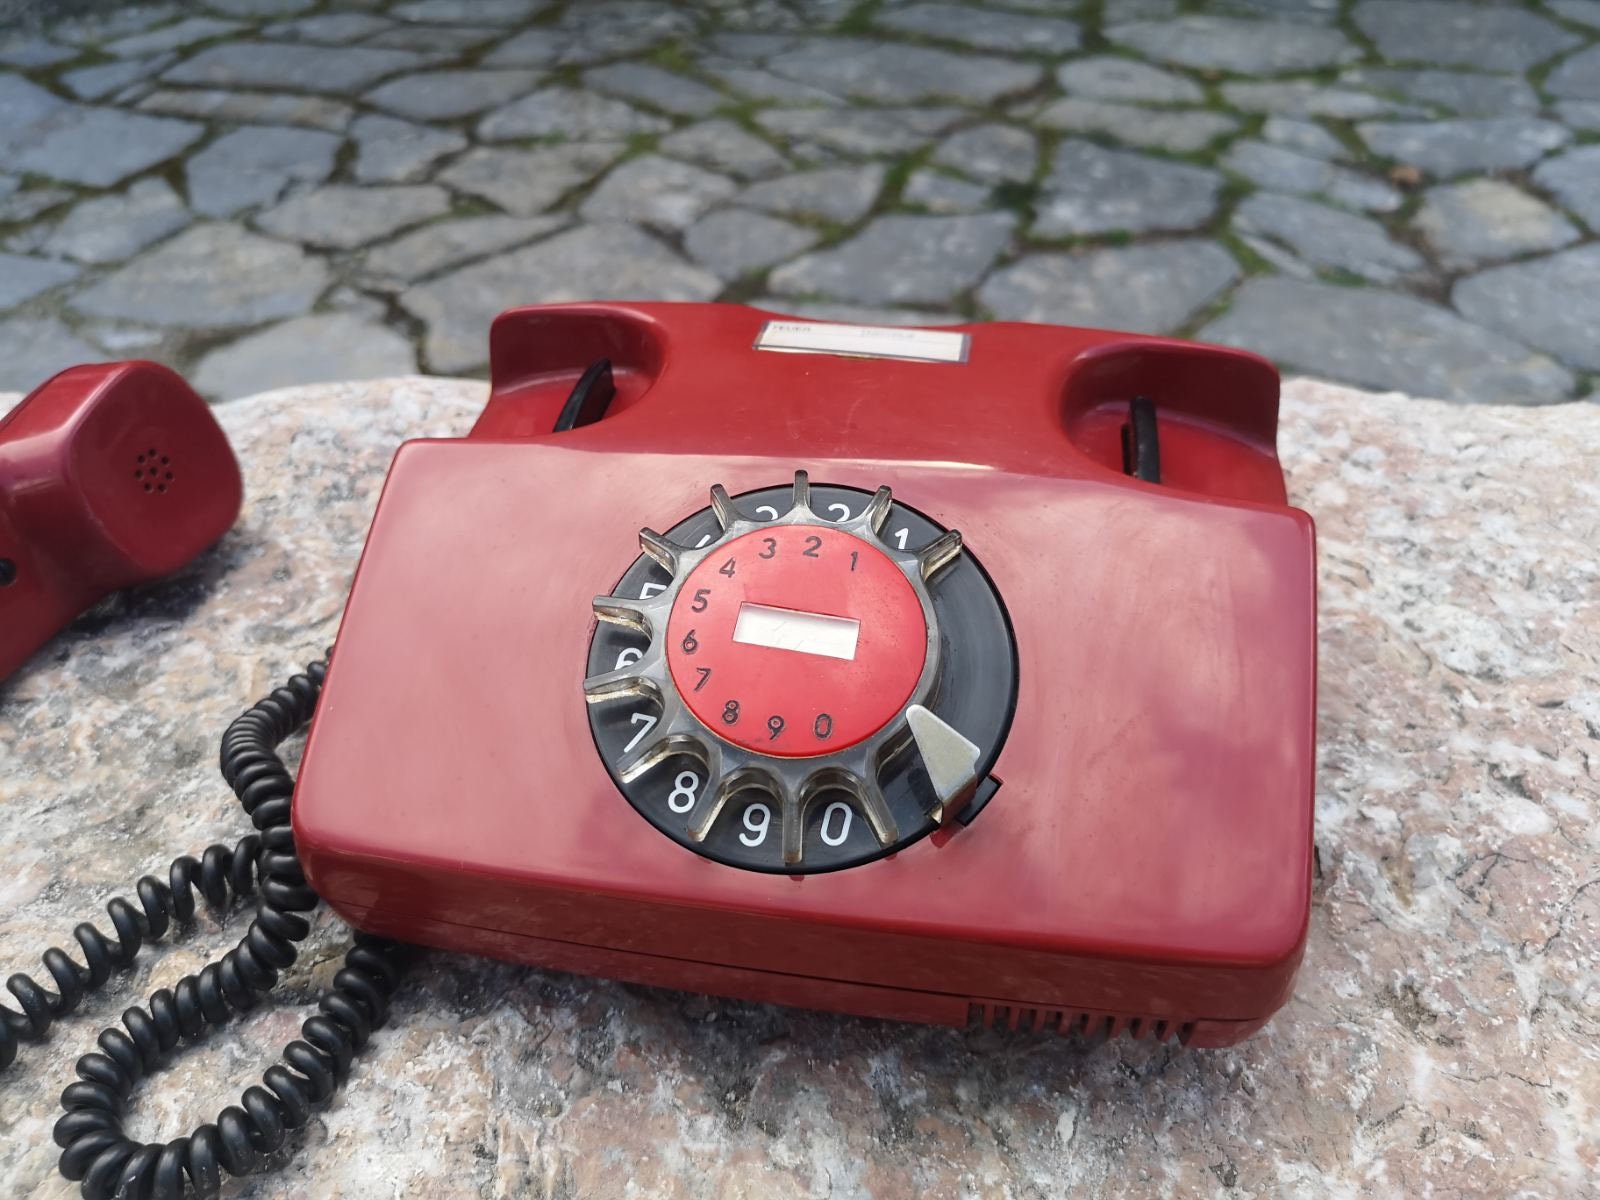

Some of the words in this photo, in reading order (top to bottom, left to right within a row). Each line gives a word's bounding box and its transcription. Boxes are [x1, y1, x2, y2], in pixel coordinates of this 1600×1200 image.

[758, 537, 777, 559] 3
[802, 535, 822, 558] 2
[719, 557, 736, 578] 4
[849, 551, 859, 572] 1
[691, 588, 711, 613] 5
[682, 629, 698, 655] 6
[694, 666, 712, 692] 7
[721, 699, 740, 725] 8
[624, 712, 657, 753] 7
[767, 715, 785, 740] 9
[813, 713, 833, 740] 0
[668, 770, 699, 814] 8
[739, 803, 771, 847] 9
[820, 801, 853, 846] 0
